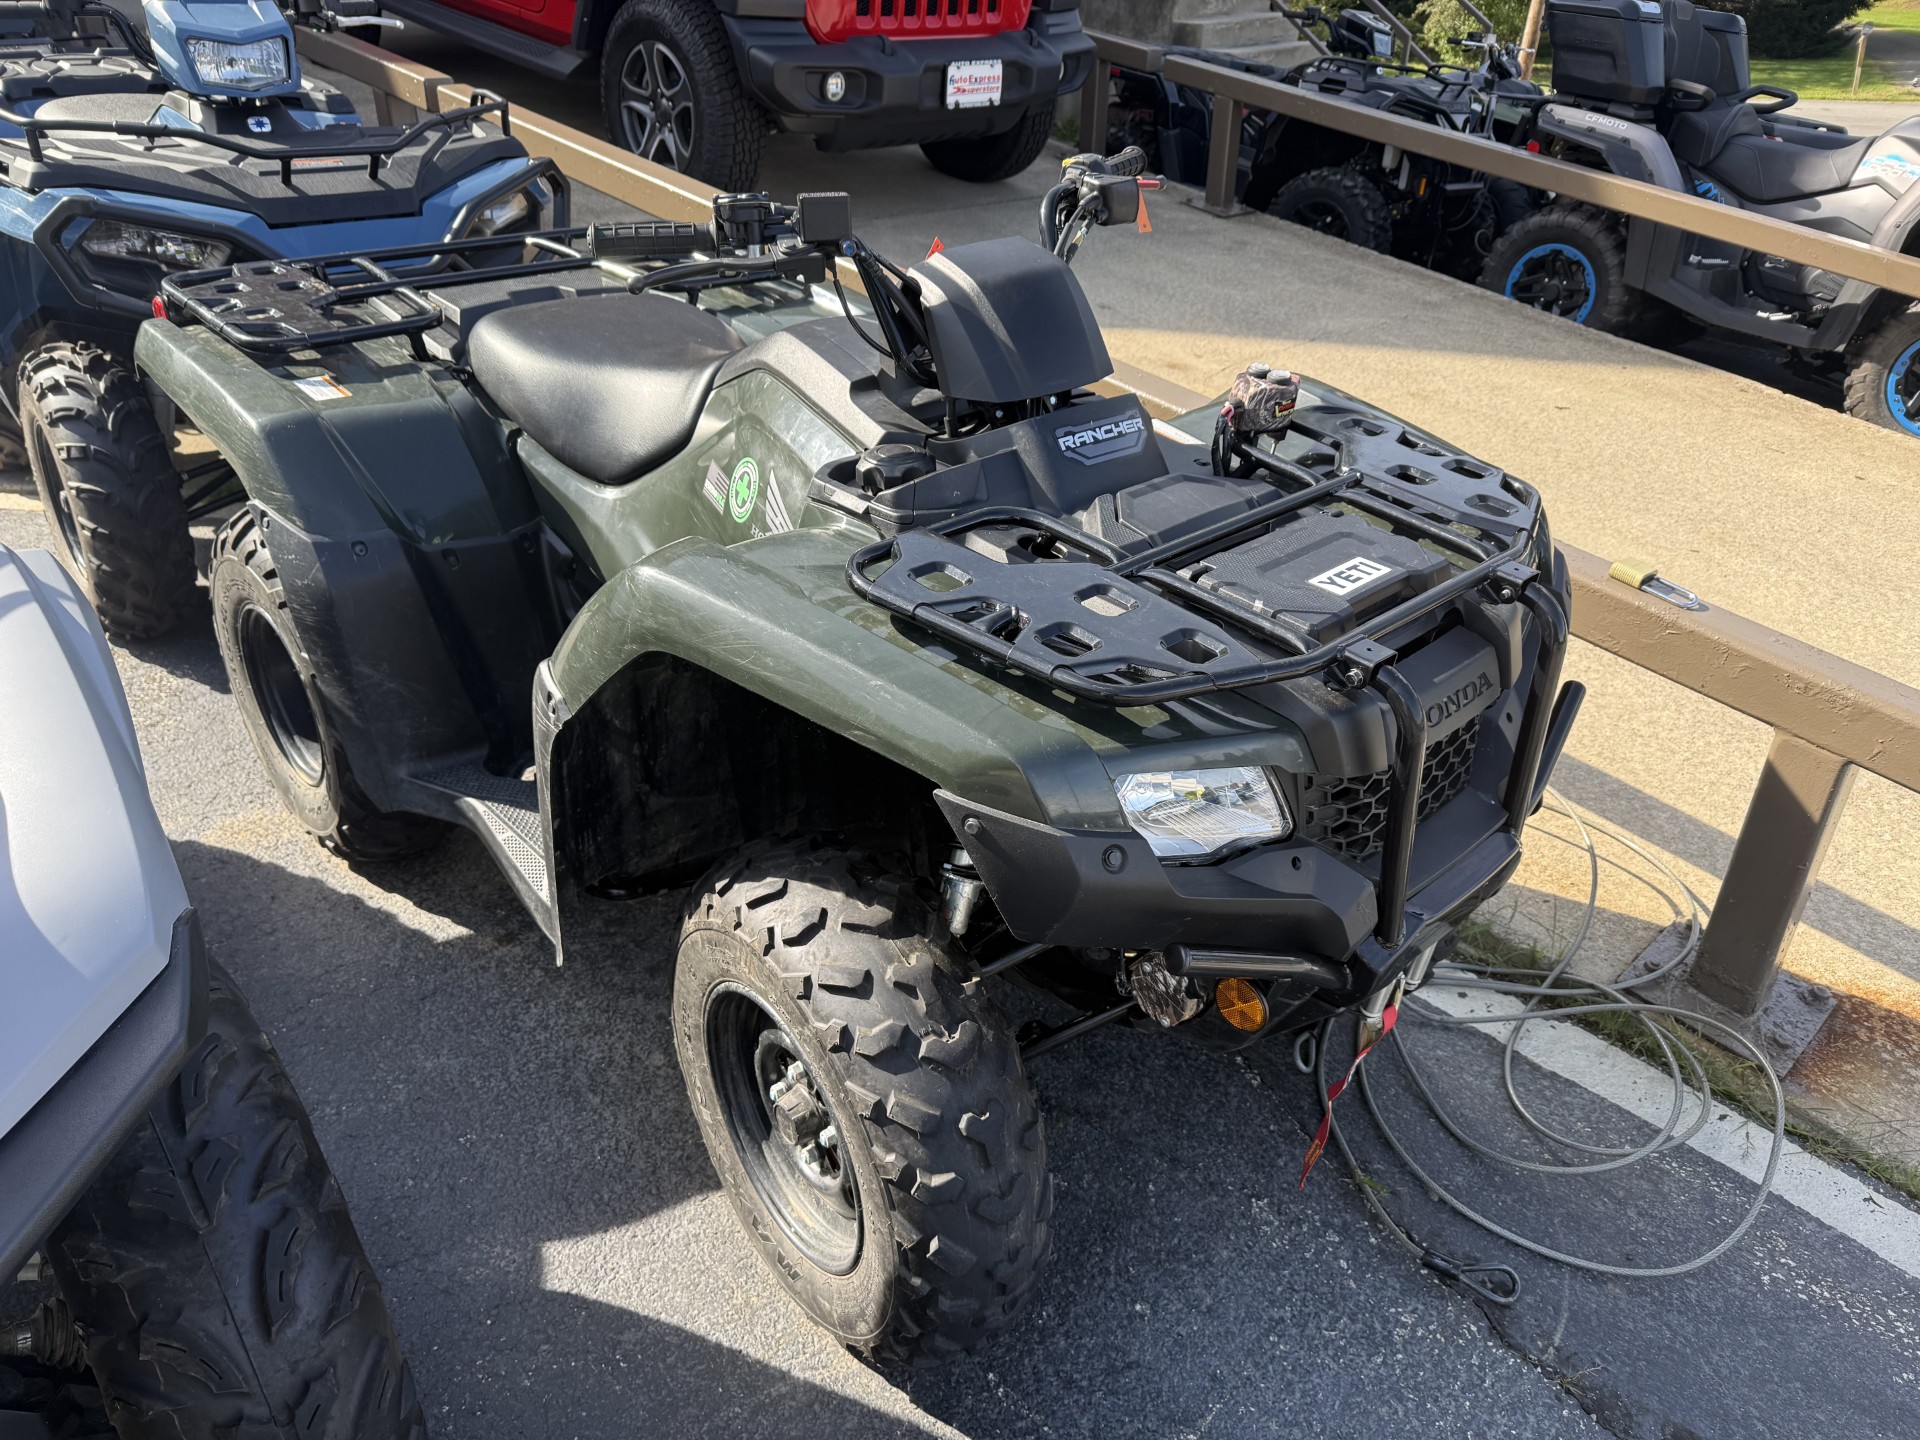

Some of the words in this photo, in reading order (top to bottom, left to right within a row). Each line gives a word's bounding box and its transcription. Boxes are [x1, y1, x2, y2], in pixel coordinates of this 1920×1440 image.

[1585, 113, 1628, 130] CFMOTO
[1058, 418, 1145, 451] RANCHER
[1317, 561, 1382, 589] YETI
[1426, 671, 1494, 728] ONDA
